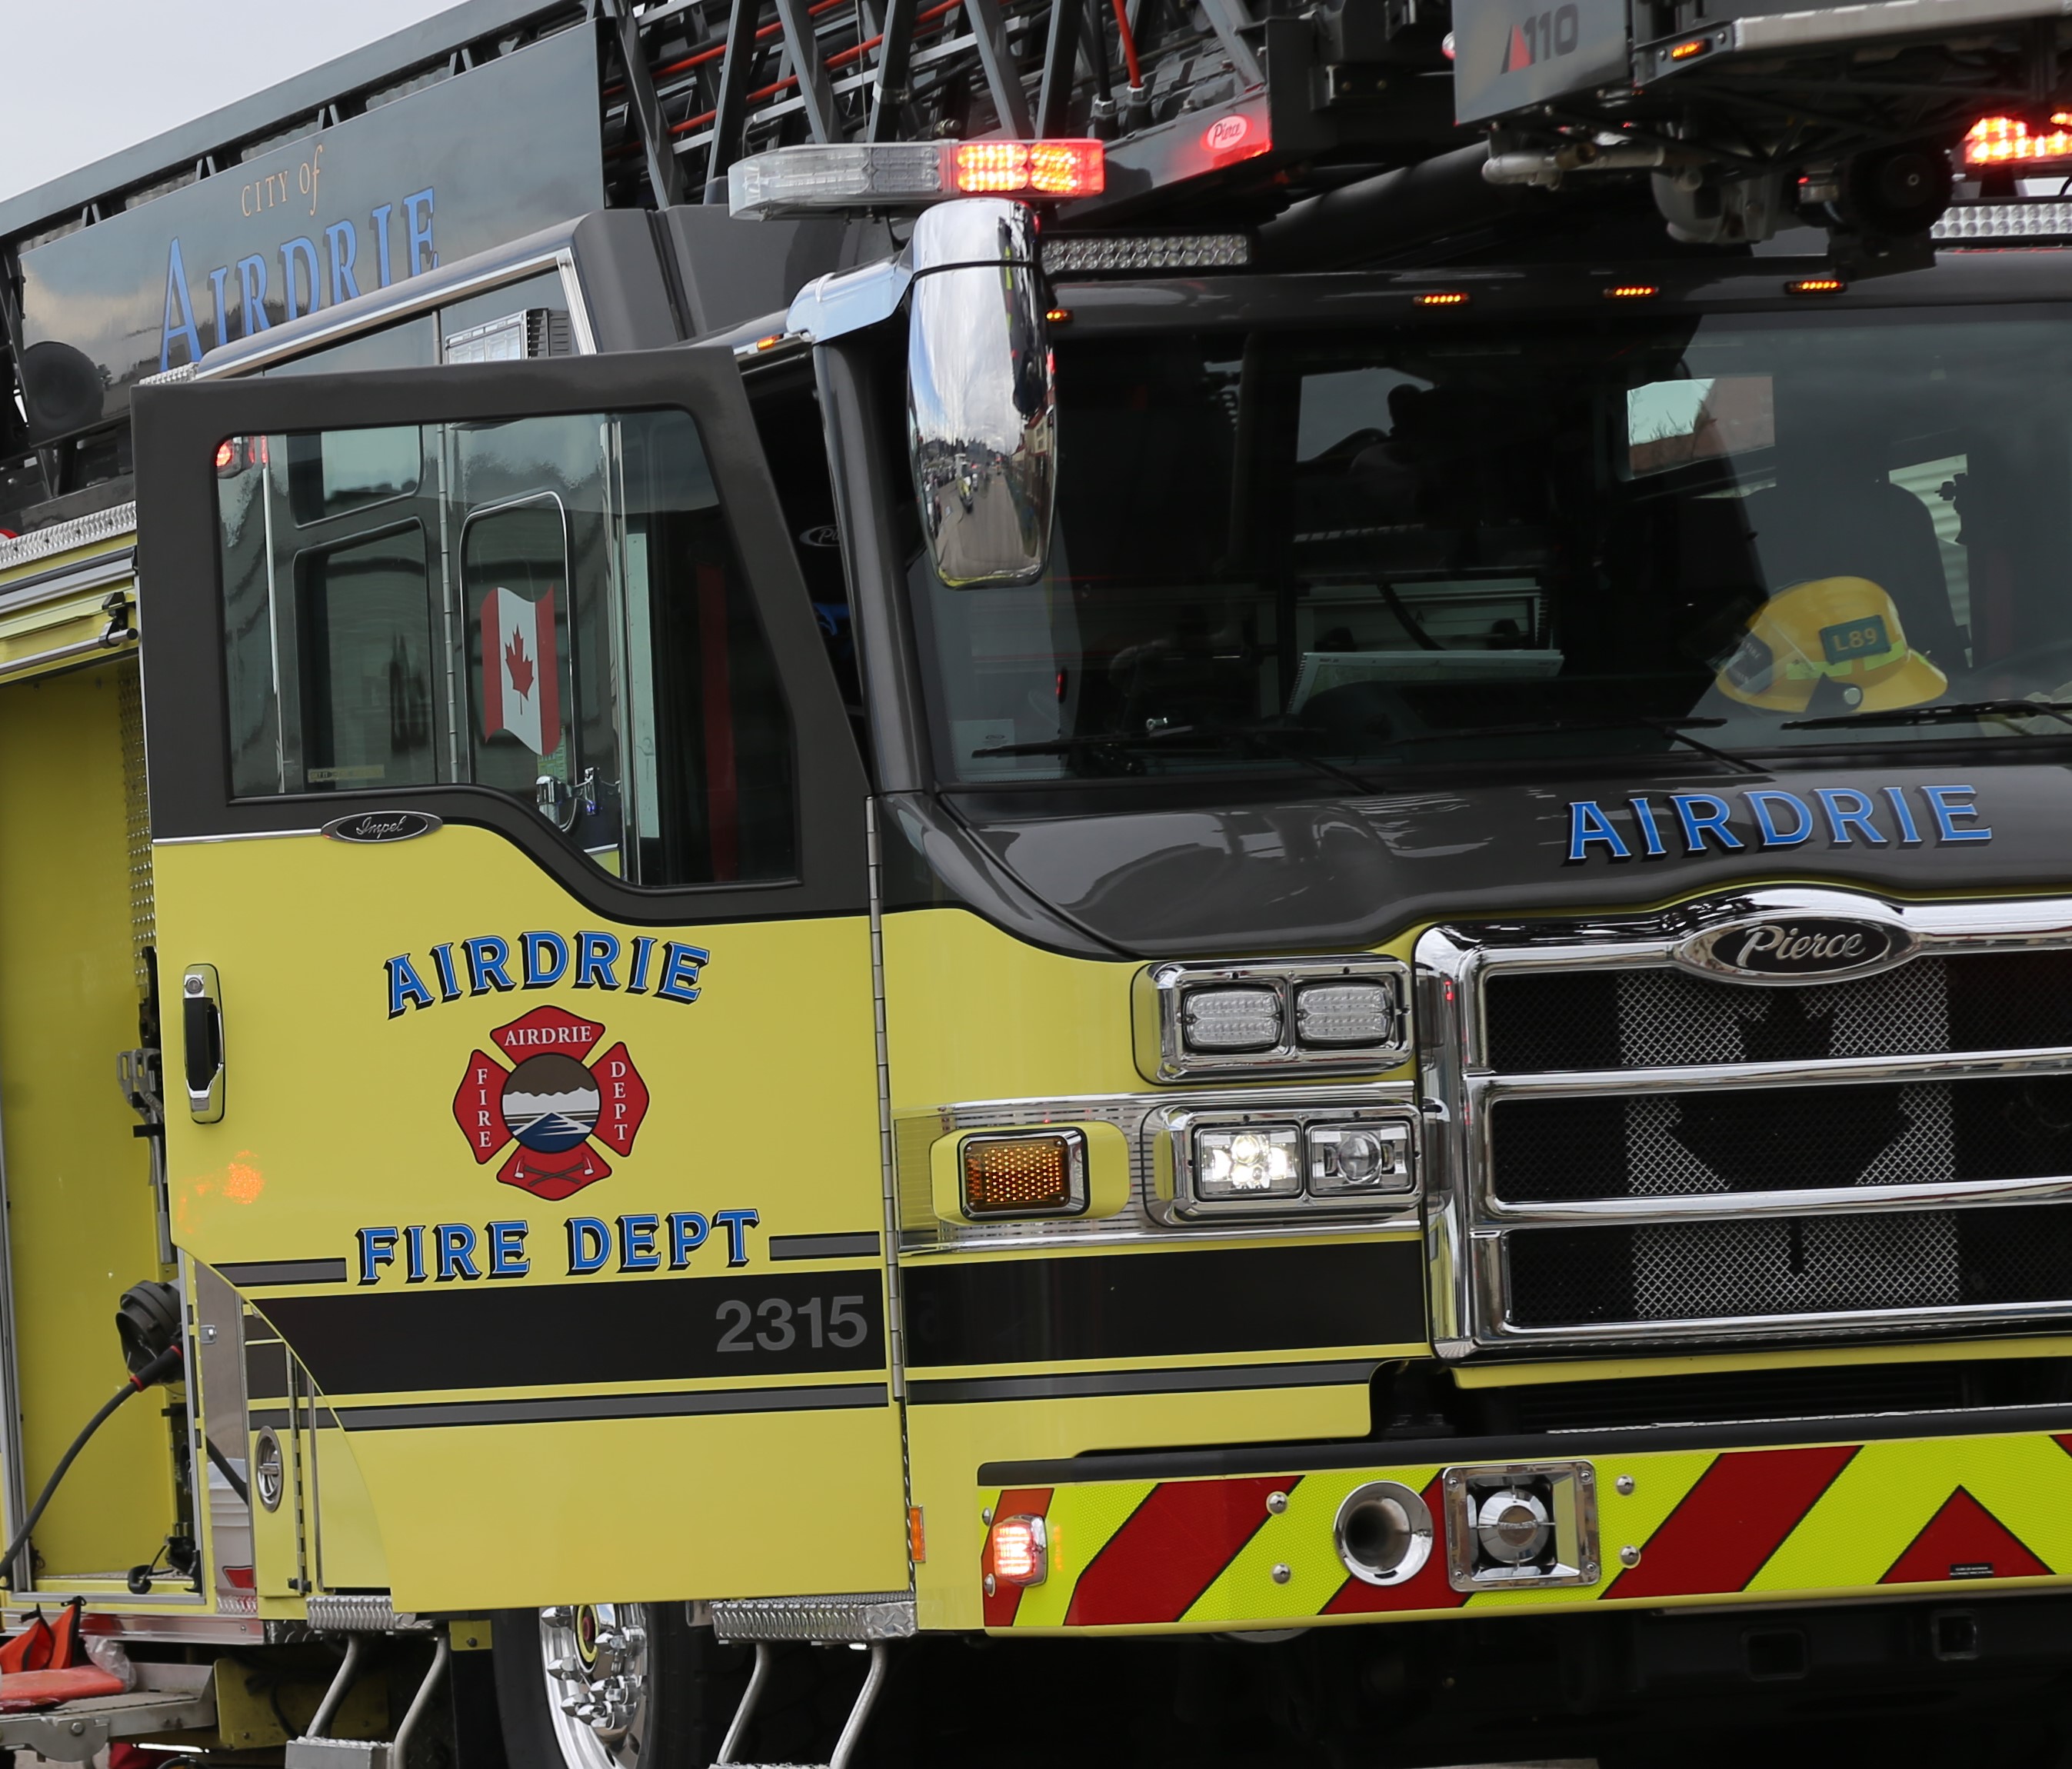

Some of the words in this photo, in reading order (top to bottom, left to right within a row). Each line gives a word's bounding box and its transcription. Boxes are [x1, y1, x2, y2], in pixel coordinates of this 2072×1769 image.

[242, 170, 288, 218] CITY
[161, 185, 439, 373] AIRDRIE
[1833, 627, 1877, 651] L89
[355, 815, 407, 839] Impel
[1566, 783, 1994, 865] AIRDRIE
[385, 930, 710, 1020] AIRDRIE
[1736, 925, 1867, 968] Pierce
[504, 1026, 592, 1046] AIRDRIE
[476, 1068, 492, 1148] FIRE
[610, 1061, 628, 1141] DEPT
[357, 1220, 531, 1286] FIRE
[565, 1208, 760, 1276] DEPT
[715, 1295, 868, 1353] 2315
